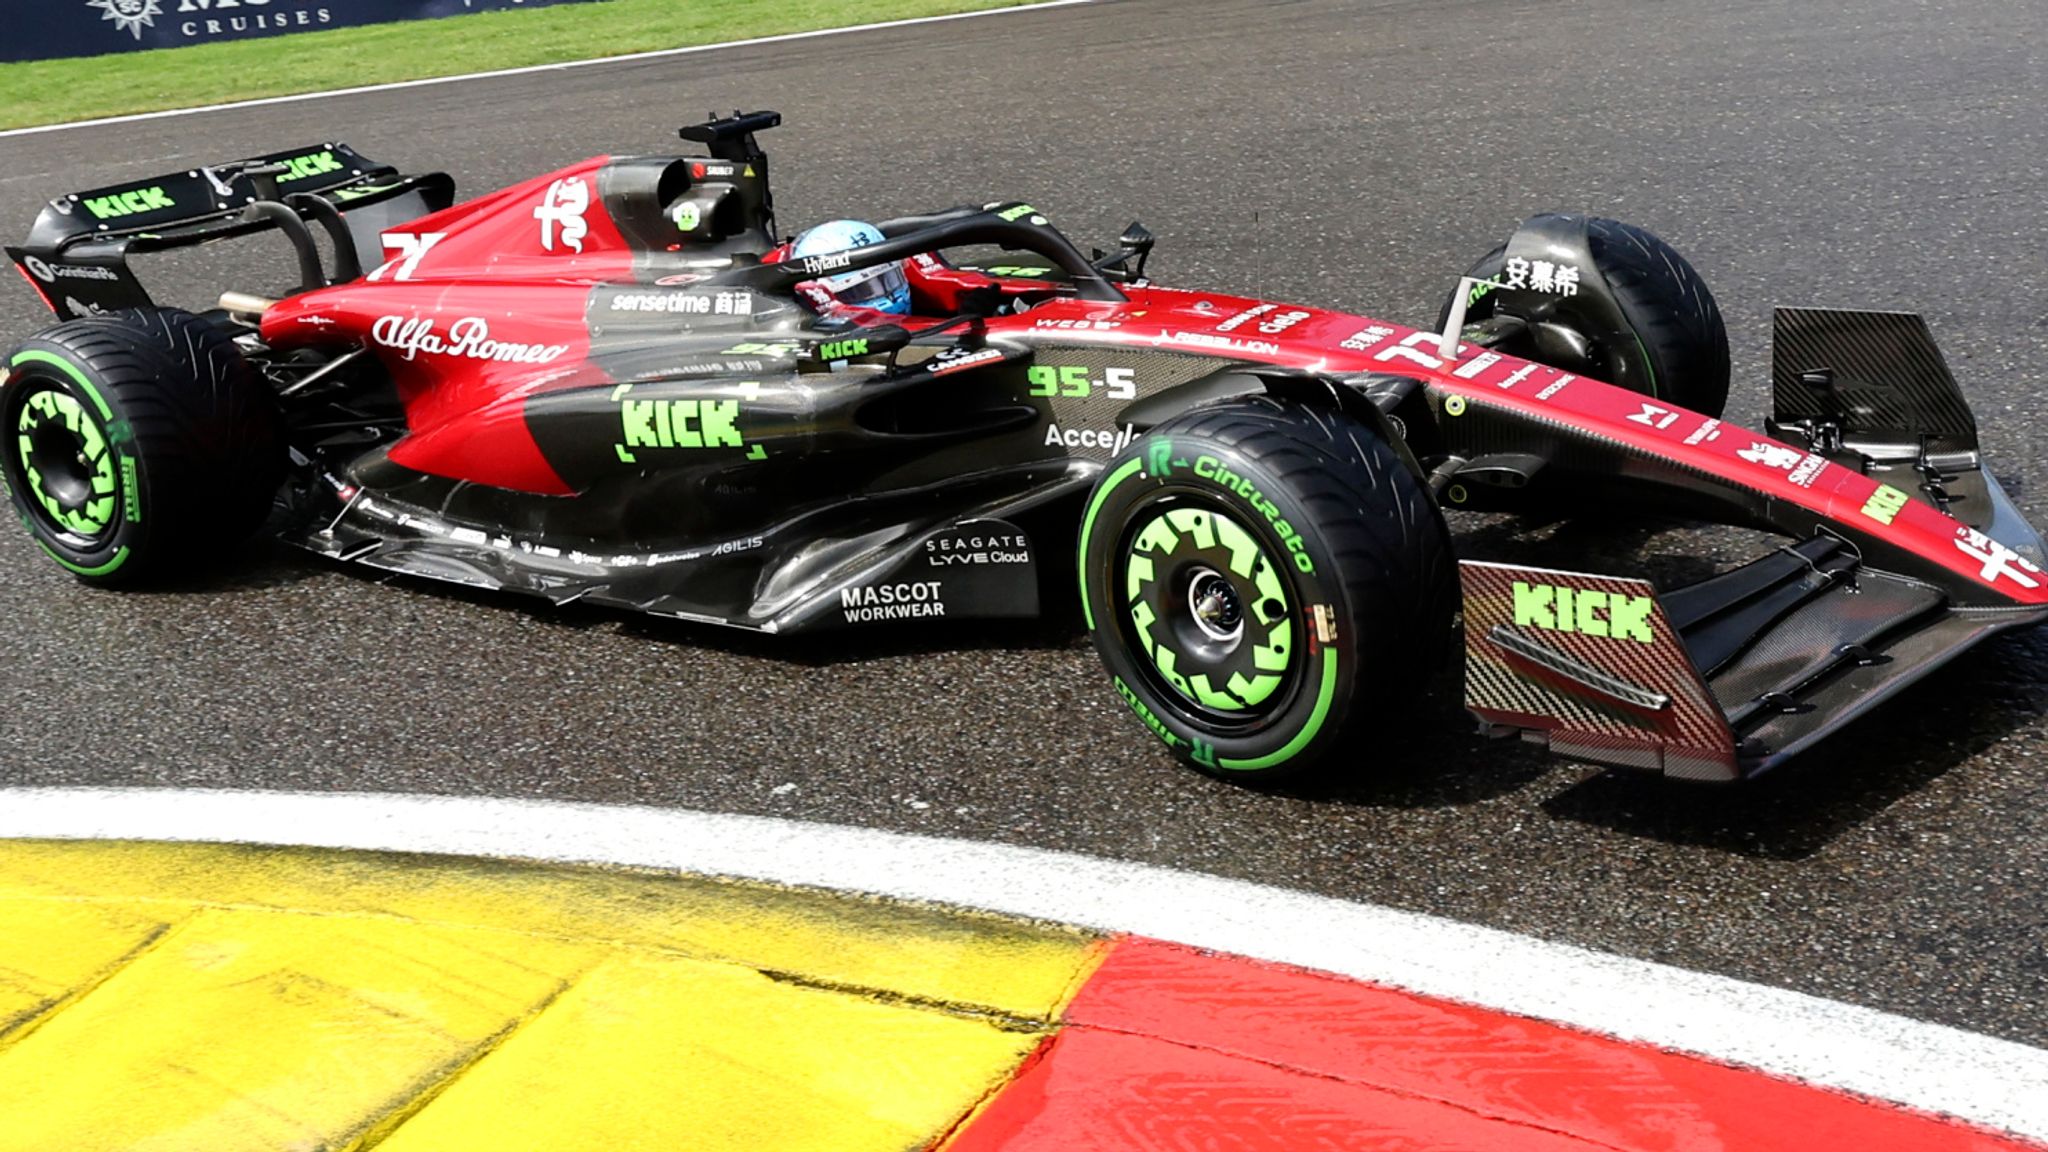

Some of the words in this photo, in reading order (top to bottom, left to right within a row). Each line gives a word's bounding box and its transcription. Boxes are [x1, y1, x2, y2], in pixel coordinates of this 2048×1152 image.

[181, 8, 331, 36] CRUISES
[83, 186, 176, 219] KICK
[804, 249, 850, 275] Hyland
[1506, 256, 1580, 298] 安慕希
[611, 293, 710, 313] sensetime
[1258, 311, 1311, 334] Cielo
[372, 315, 448, 361] Alfa
[446, 316, 569, 364] Romeo
[820, 339, 869, 361] KICK
[1173, 332, 1279, 356] REBELLION
[1026, 365, 1136, 400] 95-5
[621, 400, 743, 447] KICK
[1194, 455, 1316, 575] Cinturato
[711, 536, 763, 556] AGILIS
[926, 535, 1026, 552] SEAGATE
[929, 552, 989, 566] LYVE
[990, 549, 1029, 564] Cloud
[840, 582, 942, 608] MASCOT
[844, 602, 945, 623] WORKWEAR
[1513, 581, 1653, 643] KICK
